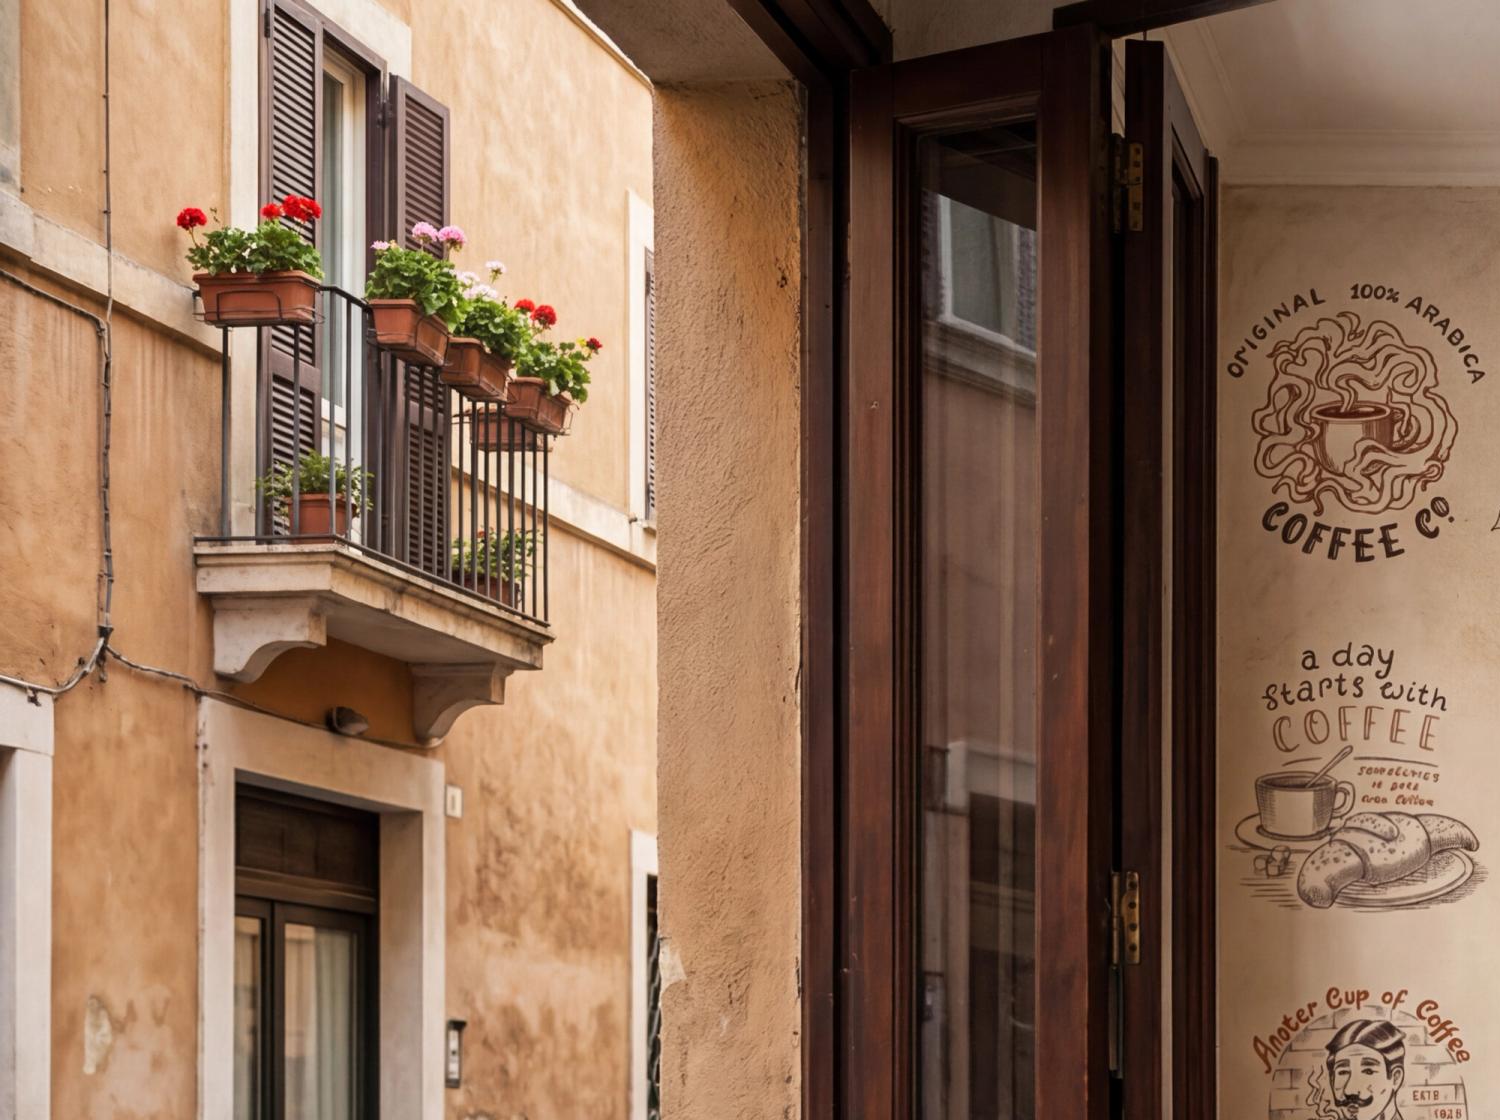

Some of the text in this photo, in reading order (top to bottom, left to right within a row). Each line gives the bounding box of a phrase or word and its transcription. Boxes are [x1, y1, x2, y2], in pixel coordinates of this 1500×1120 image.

[1349, 283, 1400, 304] 100%
[1405, 294, 1486, 384] ARABICA
[1260, 500, 1405, 563] COFFEE
[1301, 641, 1395, 680] a day
[1262, 671, 1448, 712] starts with
[1272, 704, 1441, 753] COFFEE
[1252, 986, 1471, 1075] Anoter Cup of Coffee
